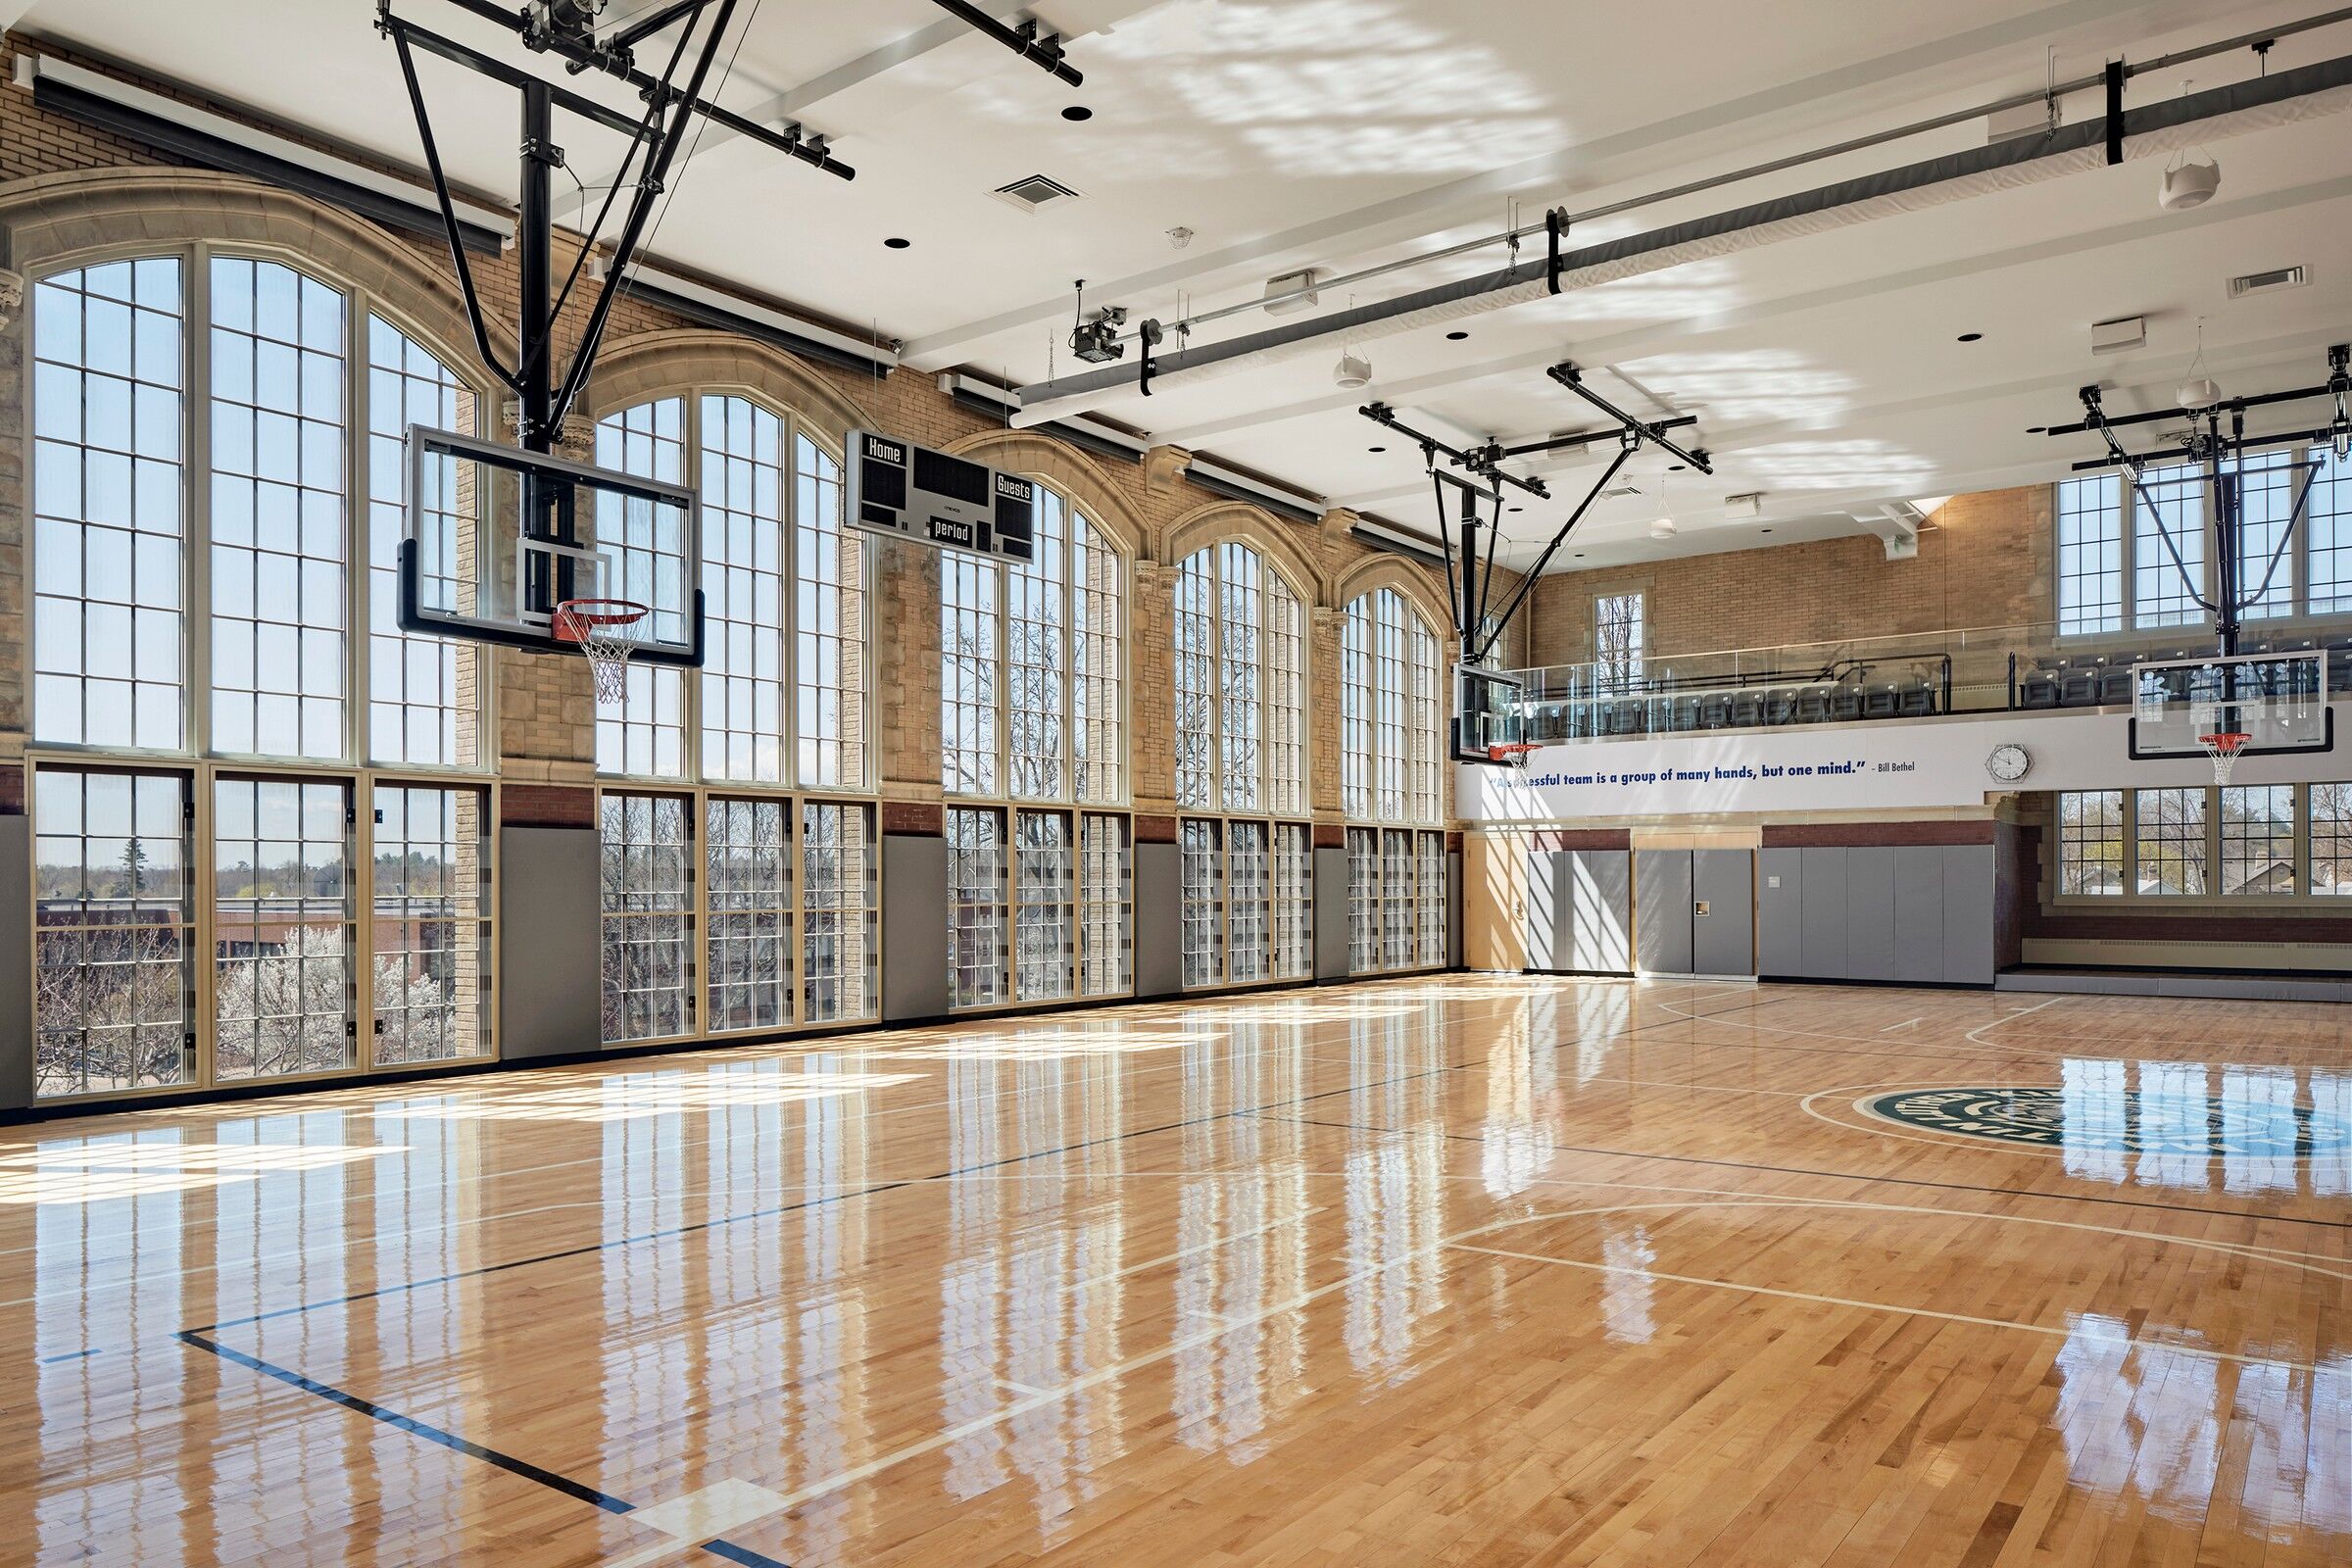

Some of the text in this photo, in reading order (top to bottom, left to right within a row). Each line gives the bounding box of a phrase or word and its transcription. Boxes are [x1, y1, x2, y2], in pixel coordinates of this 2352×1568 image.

[869, 437, 901, 463] Home
[998, 474, 1030, 499] Guests
[935, 521, 968, 541] period
[1507, 773, 1560, 787] sessful
[1563, 775, 1593, 785] team
[1596, 772, 1607, 784] is
[1609, 775, 1618, 784] a
[1621, 773, 1656, 786] group
[1659, 768, 1673, 781] of
[1676, 771, 1711, 783] many
[1714, 765, 1758, 781] hands,
[1762, 764, 1785, 777] but
[1788, 766, 1813, 776] one
[1878, 762, 1890, 772] Bill
[1891, 760, 1915, 772] Bethel
[1894, 1092, 1990, 1121] LUTHER
